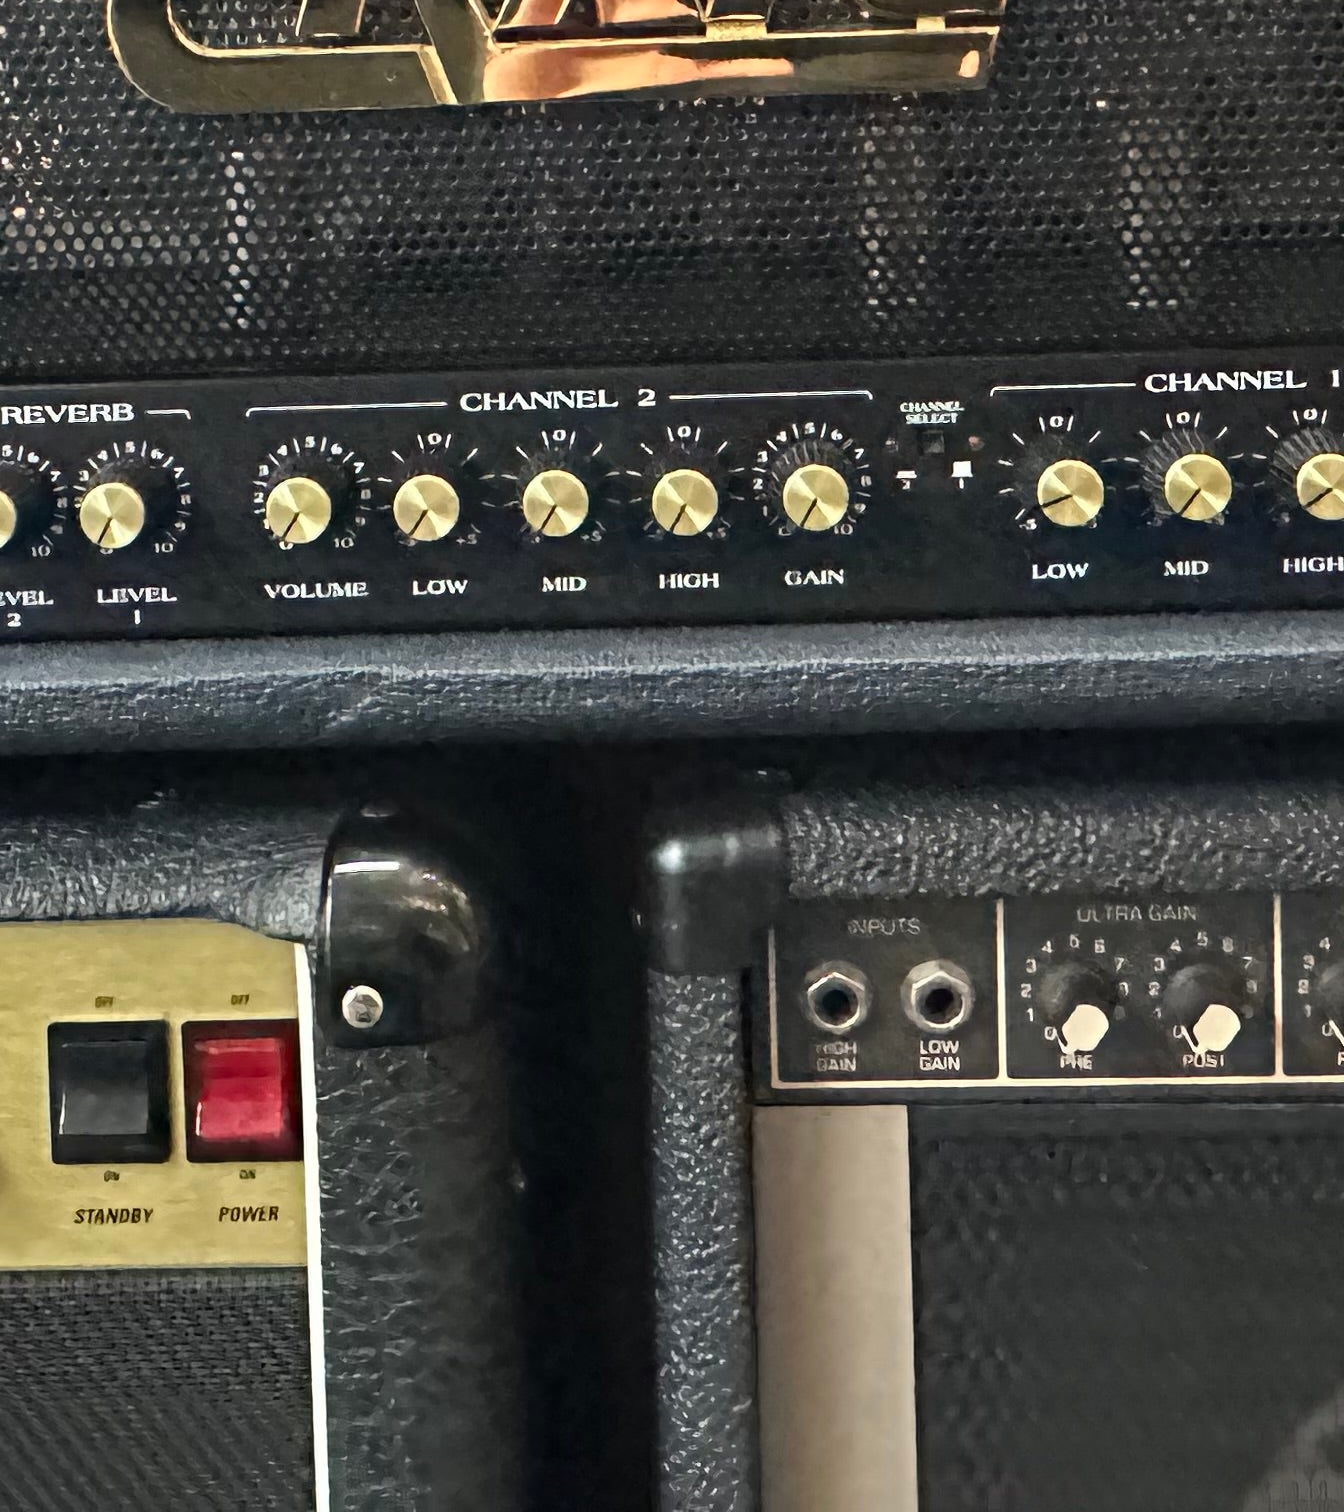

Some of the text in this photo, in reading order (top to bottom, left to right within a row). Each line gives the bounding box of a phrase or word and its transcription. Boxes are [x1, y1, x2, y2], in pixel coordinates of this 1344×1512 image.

[1144, 369, 1341, 393] CHANNEL 1
[459, 388, 656, 412] CHANNEL 2
[0, 403, 135, 424] REVERB
[1049, 415, 1064, 428] 0
[1176, 412, 1190, 423] 0
[428, 433, 442, 445] 0
[553, 429, 566, 441] 0
[678, 425, 691, 437] 0
[854, 448, 864, 459] 7
[353, 462, 365, 473] 7
[334, 537, 354, 548] 10
[1032, 562, 1089, 580] LOW
[1163, 559, 1210, 577] MID
[1283, 555, 1344, 573] HIGH
[541, 576, 587, 593] MID
[659, 572, 720, 590] HIGH
[784, 569, 845, 586] GAIN
[97, 587, 177, 604] LEVEL
[264, 582, 370, 599] VOLUME
[411, 579, 468, 596] LOW
[6, 611, 22, 627] 2
[133, 608, 141, 625] 1
[1076, 903, 1198, 923] ULTRA GAIN
[847, 917, 921, 935] INPUTS
[1242, 956, 1252, 969] 7
[1021, 983, 1031, 998] 2
[1027, 1008, 1033, 1021] 1
[919, 1039, 960, 1055] LOW
[816, 1057, 857, 1072] GAIN
[919, 1056, 961, 1072] GAIN
[73, 1207, 154, 1225] STANDBY
[218, 1205, 280, 1223] POWER
